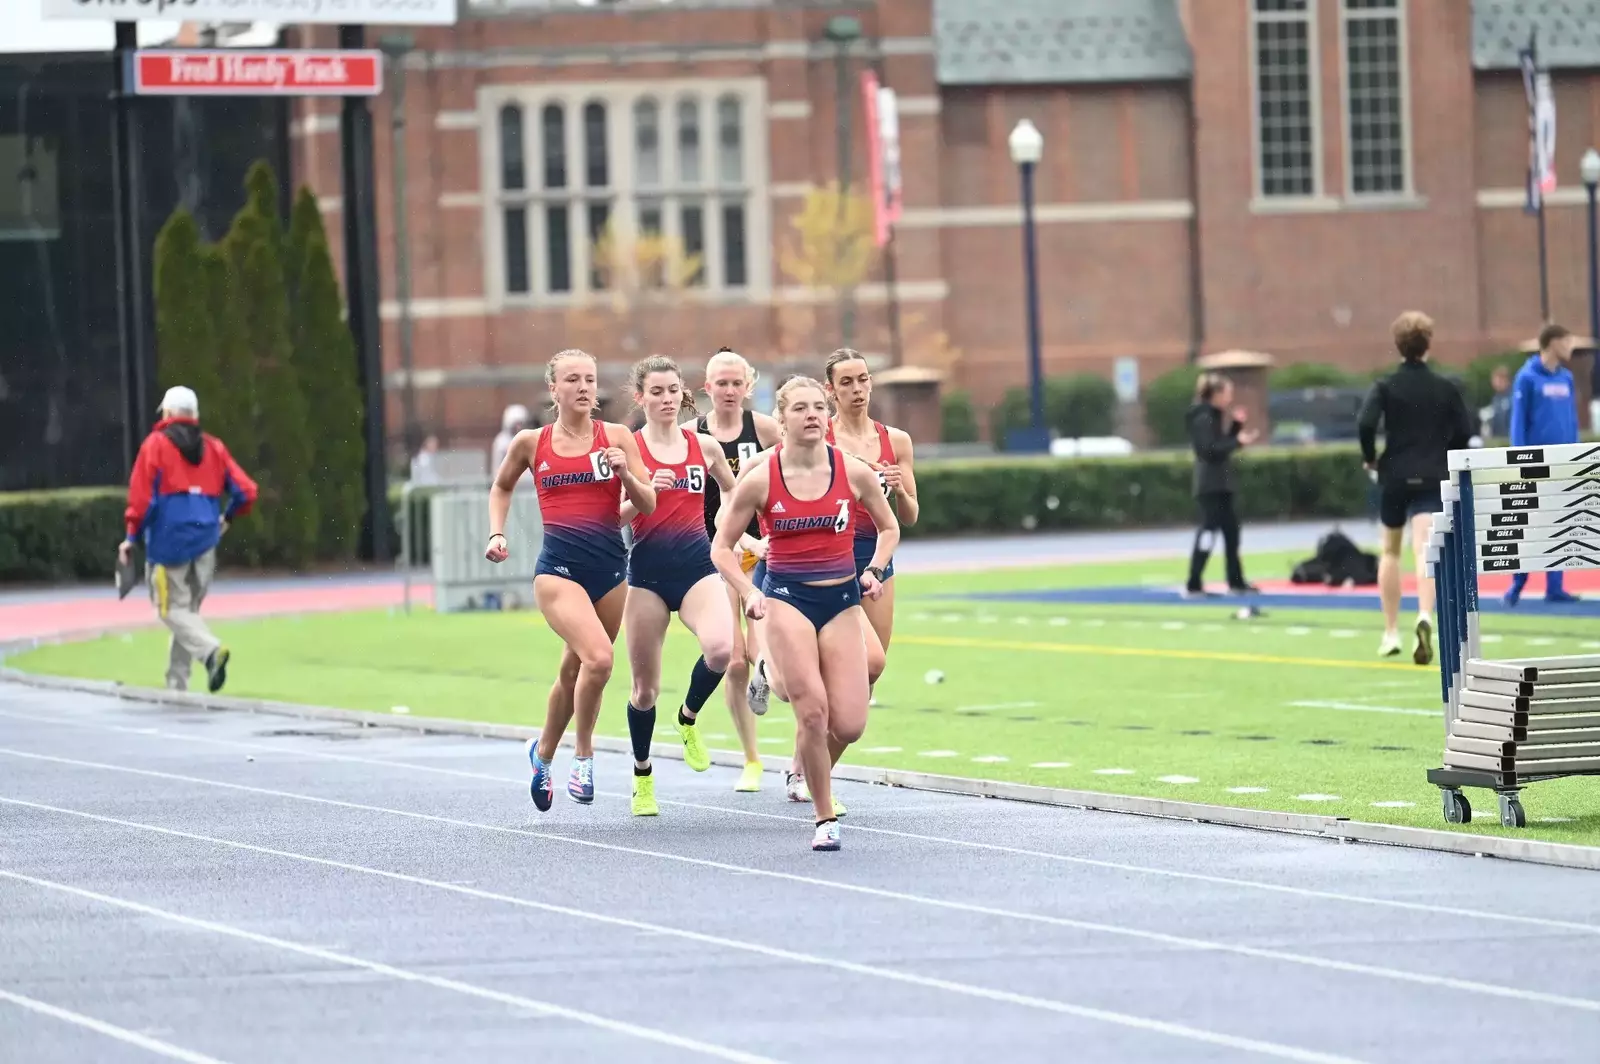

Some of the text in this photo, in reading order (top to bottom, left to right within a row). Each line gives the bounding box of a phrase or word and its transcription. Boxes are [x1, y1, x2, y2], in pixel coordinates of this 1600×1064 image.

[171, 54, 347, 89] Fred Hardy Track
[597, 452, 610, 478] 6
[542, 472, 611, 488] RICHMO
[690, 467, 702, 491] 5
[774, 514, 841, 531] RICHMO
